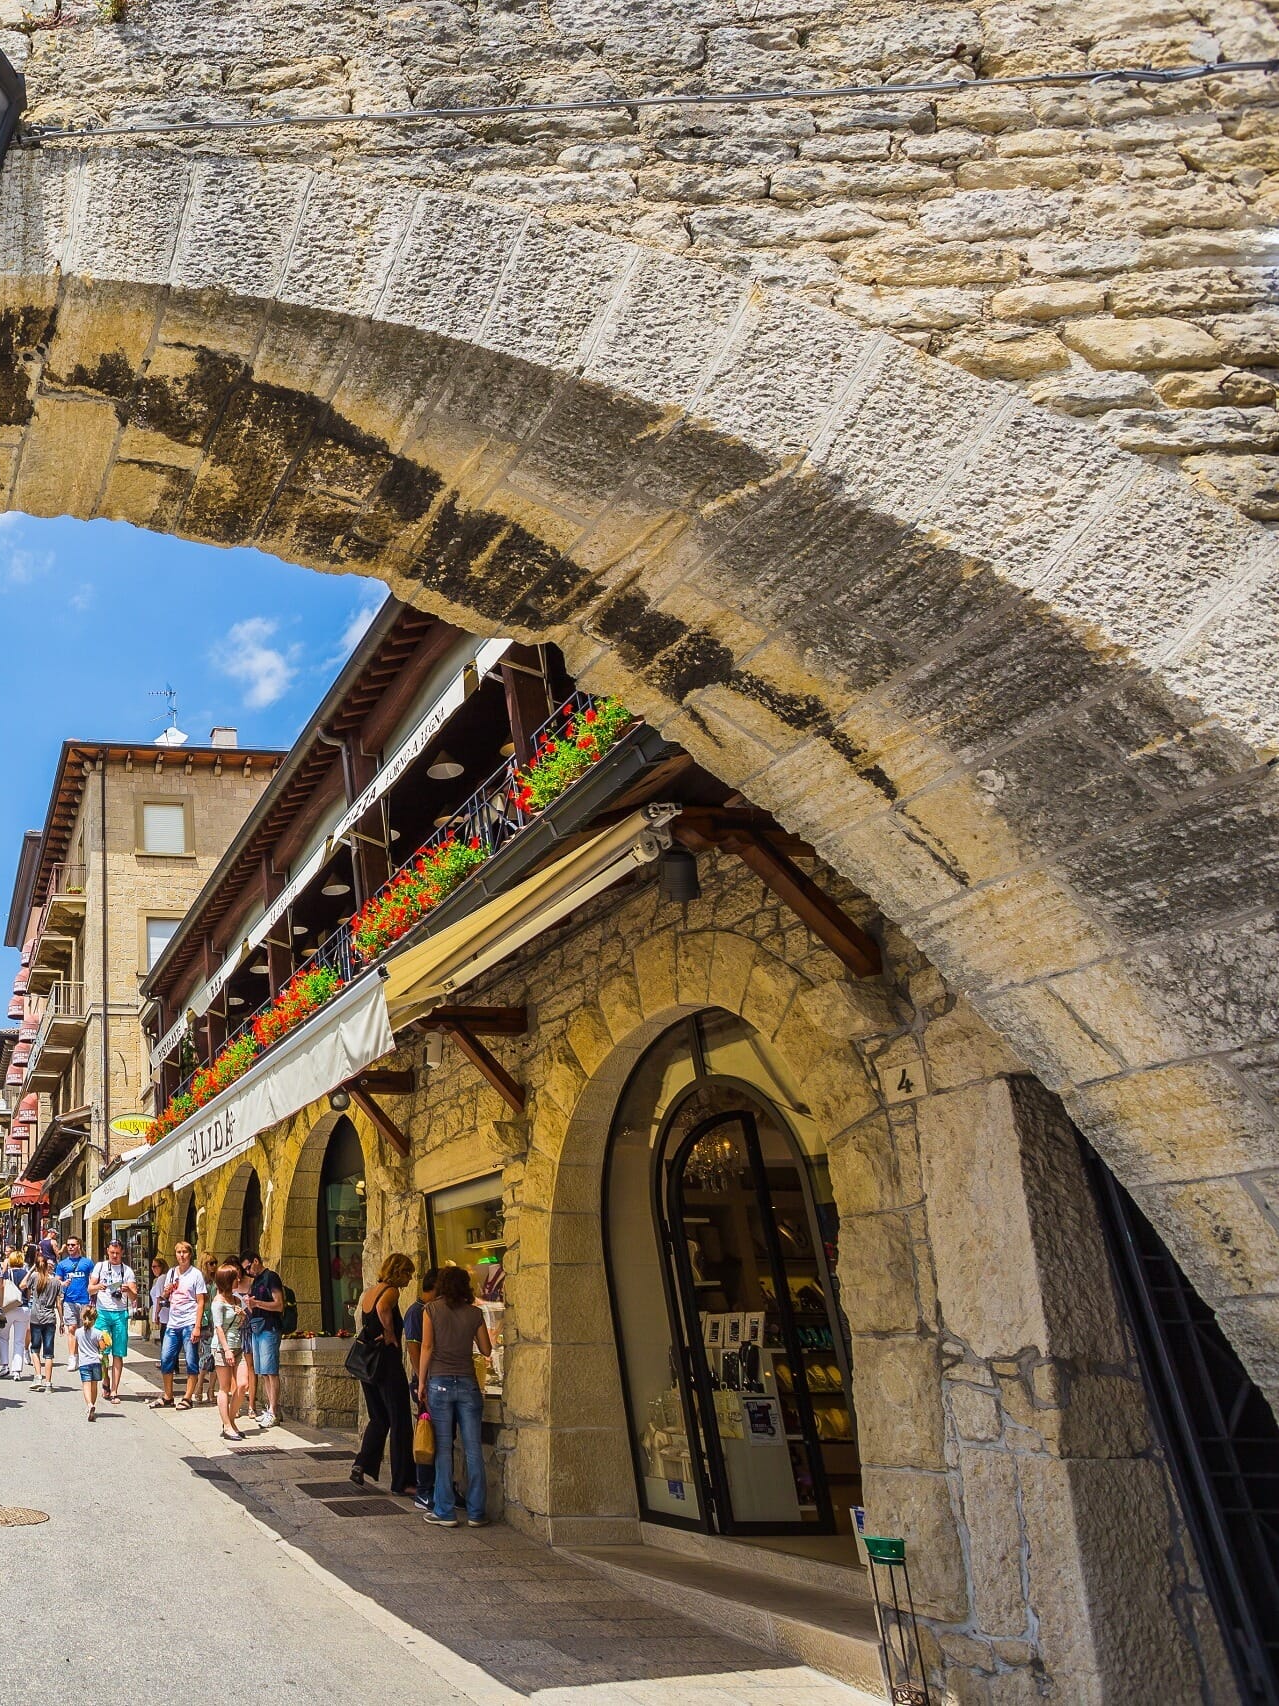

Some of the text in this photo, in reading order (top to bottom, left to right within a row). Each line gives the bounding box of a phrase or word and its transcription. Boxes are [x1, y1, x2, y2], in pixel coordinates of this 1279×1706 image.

[341, 786, 377, 832] PIZZA
[210, 976, 222, 998] BAR
[157, 1025, 181, 1062] RISTORANTE
[897, 1069, 914, 1093] 4
[119, 1121, 128, 1129] LA
